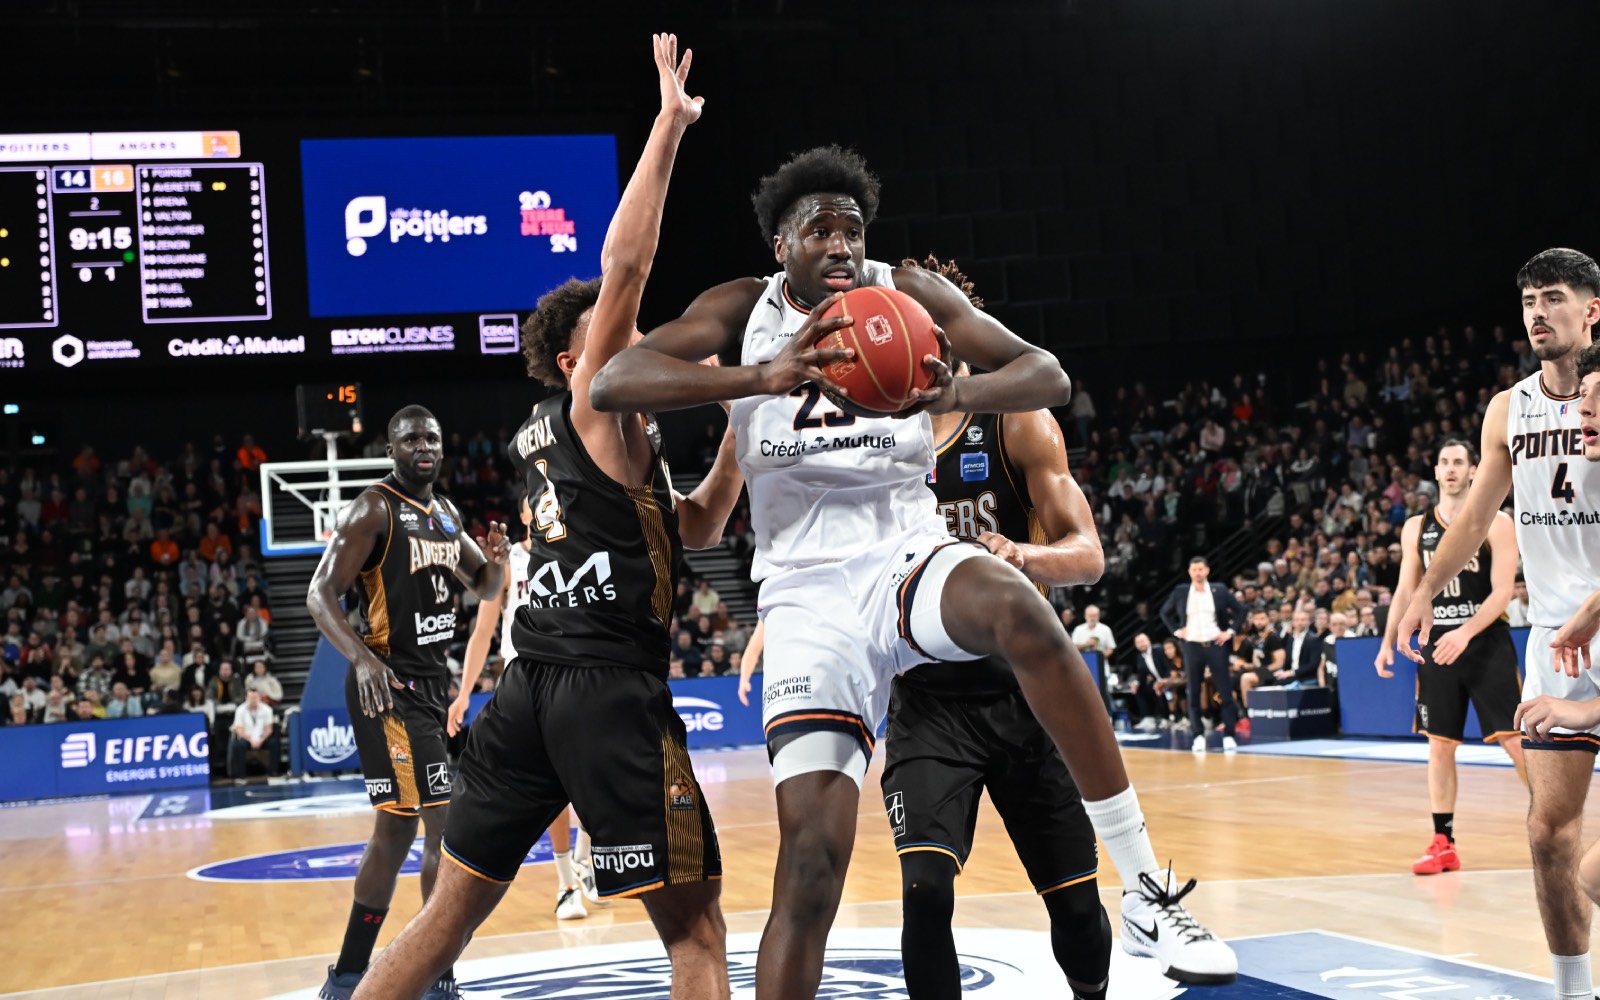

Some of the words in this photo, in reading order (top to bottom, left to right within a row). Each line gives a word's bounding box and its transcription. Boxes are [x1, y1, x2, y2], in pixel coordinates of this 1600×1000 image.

[119, 141, 177, 151] ANGERS
[60, 170, 86, 187] 14
[101, 170, 126, 186] 16
[90, 197, 99, 211] 2
[519, 190, 551, 210] 20
[390, 209, 488, 243] poitiers
[69, 226, 132, 250] 9:15
[550, 233, 577, 252] 24
[79, 267, 92, 283] 0
[105, 266, 116, 282] 1
[168, 338, 223, 357] Crédit
[244, 335, 305, 354] Mutuel
[338, 385, 357, 404] 15
[516, 415, 557, 461] BRENA
[760, 439, 807, 457] Crédit
[832, 433, 896, 448] Mutuel
[1511, 428, 1586, 466] POITIE
[1551, 462, 1575, 504] 4
[534, 458, 567, 543] 4
[1520, 511, 1558, 526] Crédit
[408, 536, 461, 575] ANGERS
[529, 550, 612, 597] KIA
[528, 584, 617, 610] NGERS
[767, 675, 811, 692] TECHNIQUE
[767, 684, 812, 704] SOLAIRE
[104, 731, 209, 765] EIFFAG
[106, 765, 156, 783] ÉNERGIE
[673, 795, 692, 805] EAB
[593, 852, 655, 873] anjou
